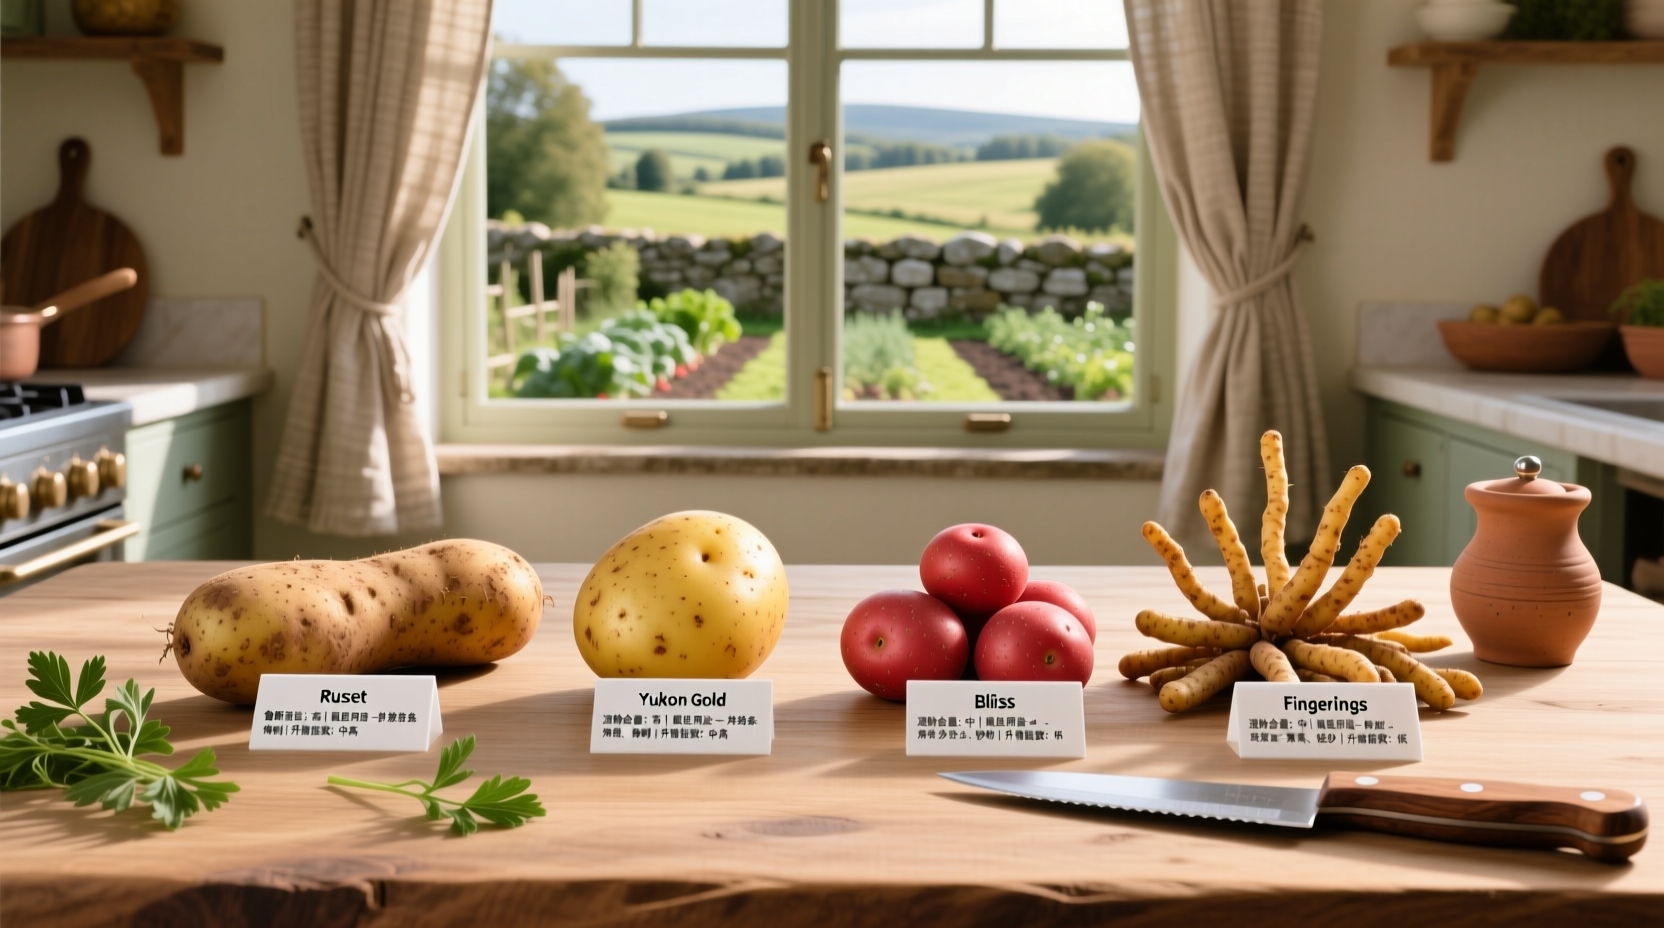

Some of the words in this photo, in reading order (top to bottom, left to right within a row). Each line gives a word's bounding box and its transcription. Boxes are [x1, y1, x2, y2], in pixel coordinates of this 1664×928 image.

[320, 689, 368, 704] Ruset
[639, 691, 687, 708] Yukon
[691, 692, 727, 707] Gold
[1283, 695, 1368, 716] Fingerings
